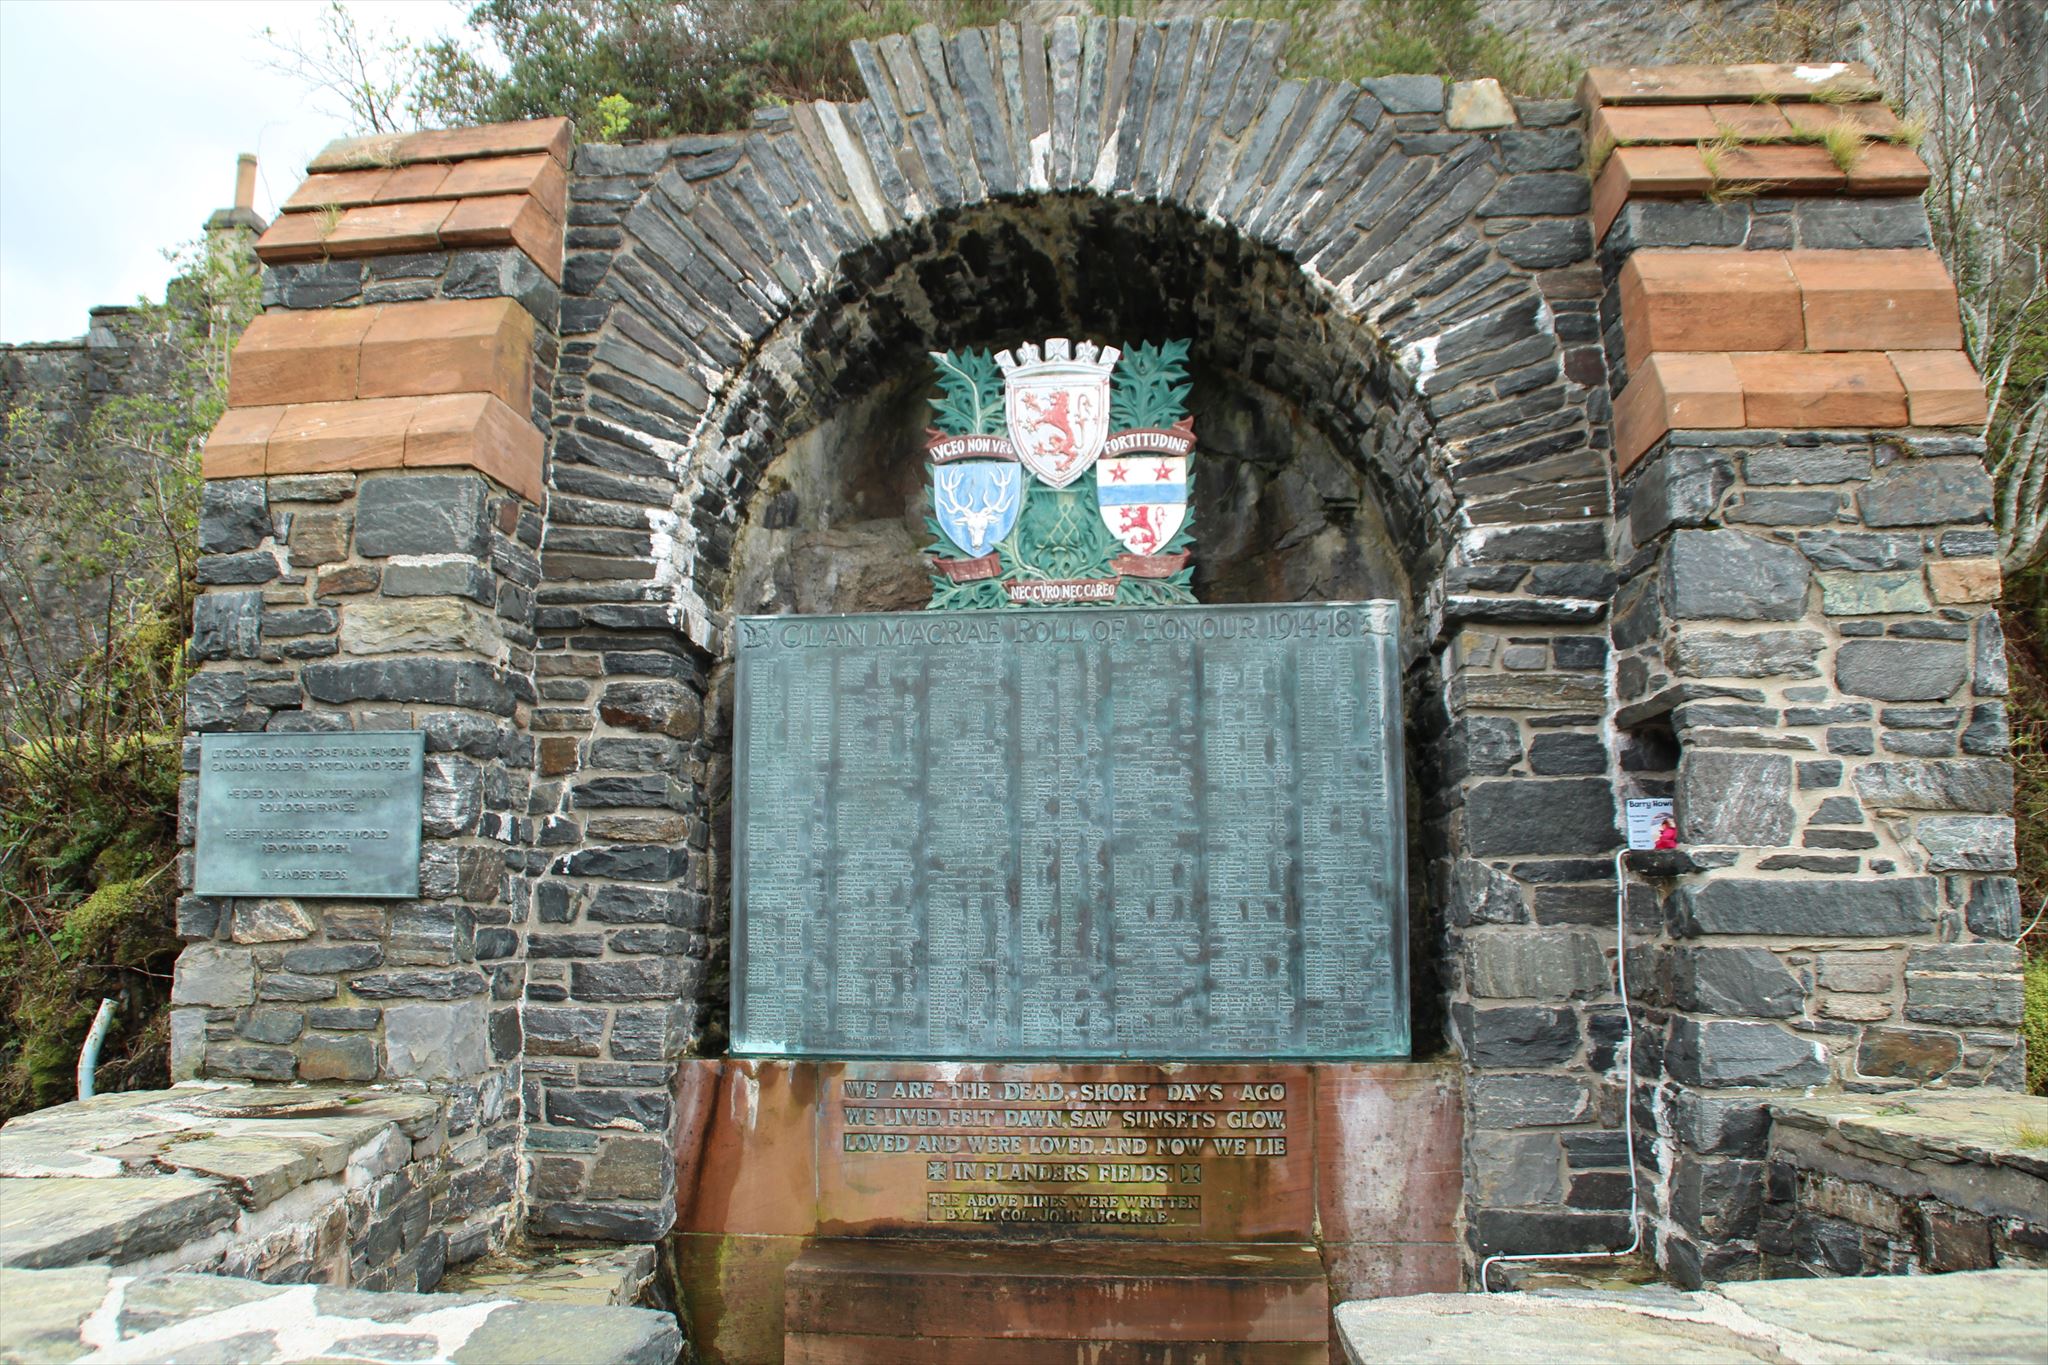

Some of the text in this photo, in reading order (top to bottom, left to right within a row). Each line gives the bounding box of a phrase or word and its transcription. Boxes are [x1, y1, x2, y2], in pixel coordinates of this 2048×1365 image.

[967, 438, 991, 453] NON
[1104, 432, 1190, 455] FORTITUDINE
[1011, 583, 1115, 600] NEC CVRO NEC CAREO
[779, 624, 866, 648] CLAN
[1014, 617, 1084, 644] ROLL
[1092, 617, 1128, 641] OF
[1136, 613, 1258, 641] HONOUR
[1268, 608, 1353, 640] 1914-18
[224, 747, 269, 759] COLONEL
[270, 747, 297, 760] JOHN
[371, 746, 411, 757] FAMOUS
[211, 761, 263, 772] CANADIAN
[308, 760, 357, 771] PHYSICIAN
[358, 760, 381, 771] AND
[227, 788, 241, 799] HE
[241, 788, 265, 799] DIED
[267, 788, 282, 799] ON
[284, 788, 327, 800] JANUARY
[379, 788, 390, 799] IN
[259, 802, 316, 813] BOULOGNE
[1629, 801, 1651, 809] Barry
[224, 829, 390, 840] HE LEFT US HIS LEGACY THE WORLD
[261, 843, 320, 854] RENOWNED
[261, 869, 271, 880] IN
[273, 869, 317, 880] FLANDERS
[845, 1081, 878, 1099] WE
[892, 1082, 936, 1100] ARE
[948, 1082, 991, 1100] THE
[1080, 1083, 1149, 1101] SHORT
[1167, 1084, 1225, 1102] DAYS
[1240, 1084, 1286, 1102] AGO
[845, 1108, 877, 1126] WE
[947, 1109, 995, 1127] FELT
[1070, 1110, 1112, 1128] SAW
[1122, 1111, 1217, 1129] SUNSETS
[1226, 1111, 1287, 1131] GLOW,
[844, 1135, 911, 1153] LOVED
[914, 1136, 962, 1153] AND
[967, 1136, 1024, 1154] WERE
[1101, 1137, 1148, 1155] AND
[1156, 1138, 1204, 1156] NOW
[1213, 1138, 1247, 1156] WE
[1255, 1138, 1287, 1156] LIE
[953, 1162, 1173, 1183] IN FLANDERS FIELDS.
[929, 1193, 1199, 1210] THE ABOVE LINES WERE WRITTEN
[946, 1207, 969, 1220] BY
